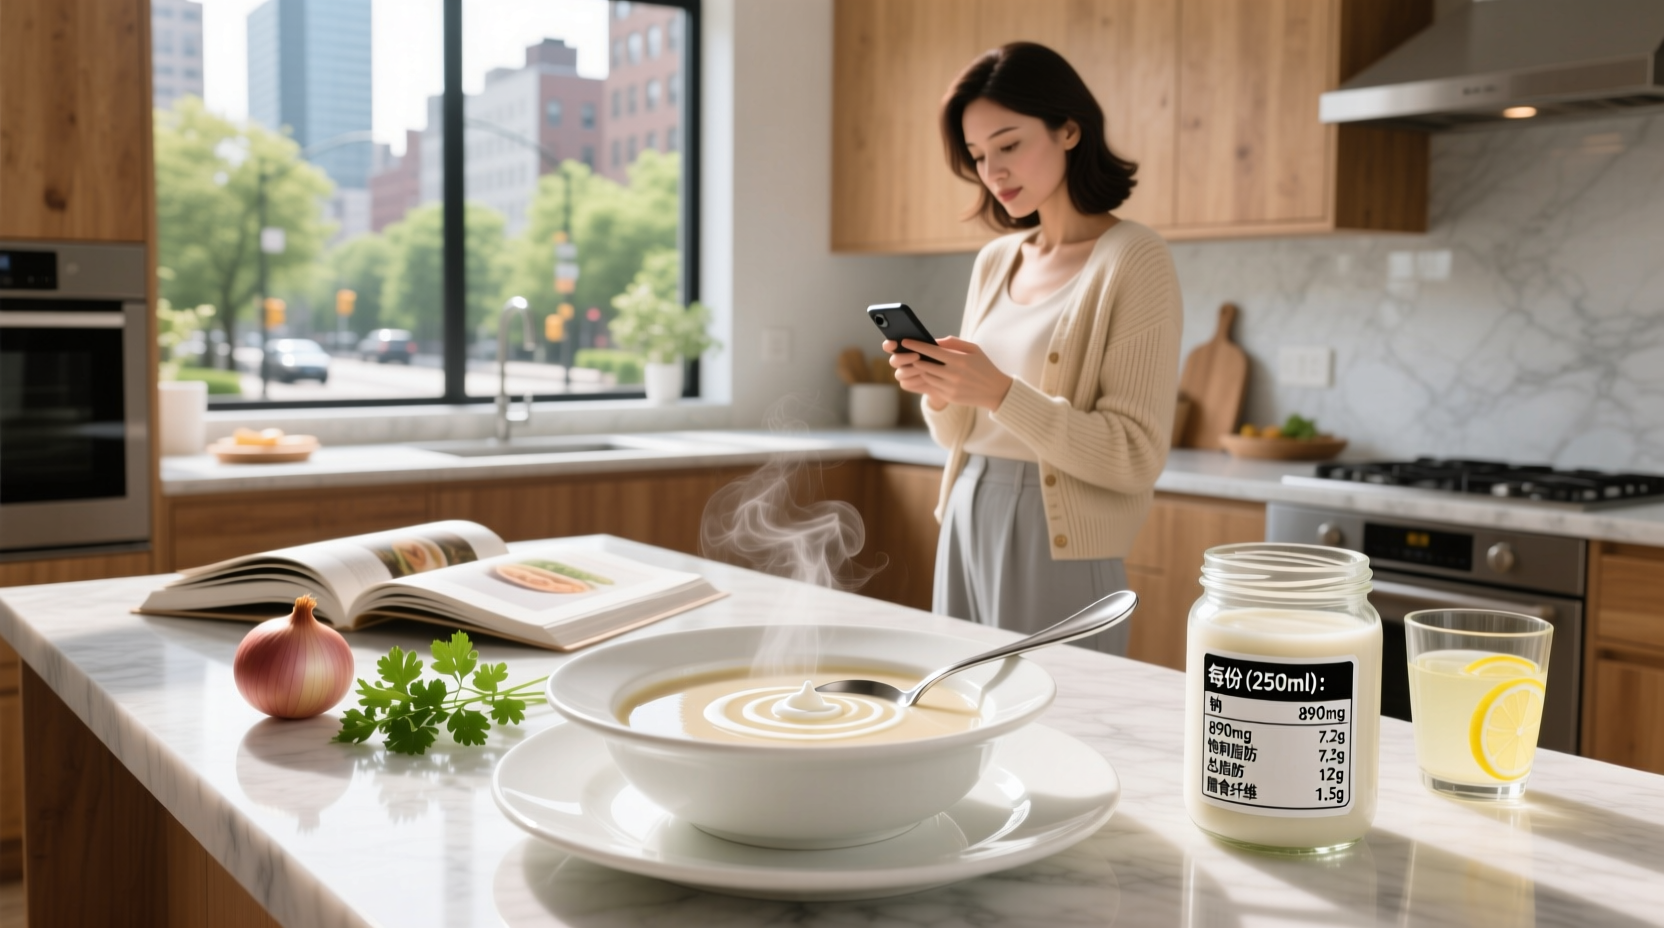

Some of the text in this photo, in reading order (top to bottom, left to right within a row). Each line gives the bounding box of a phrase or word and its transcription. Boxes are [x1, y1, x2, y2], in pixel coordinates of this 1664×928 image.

[1208, 662, 1325, 695] 每份 (250ml):
[1298, 705, 1346, 721] 890mg
[1209, 721, 1252, 744] 890mg
[1319, 730, 1345, 744] 7.2g
[1319, 767, 1344, 784] 12g
[1315, 787, 1344, 803] 1.5g
